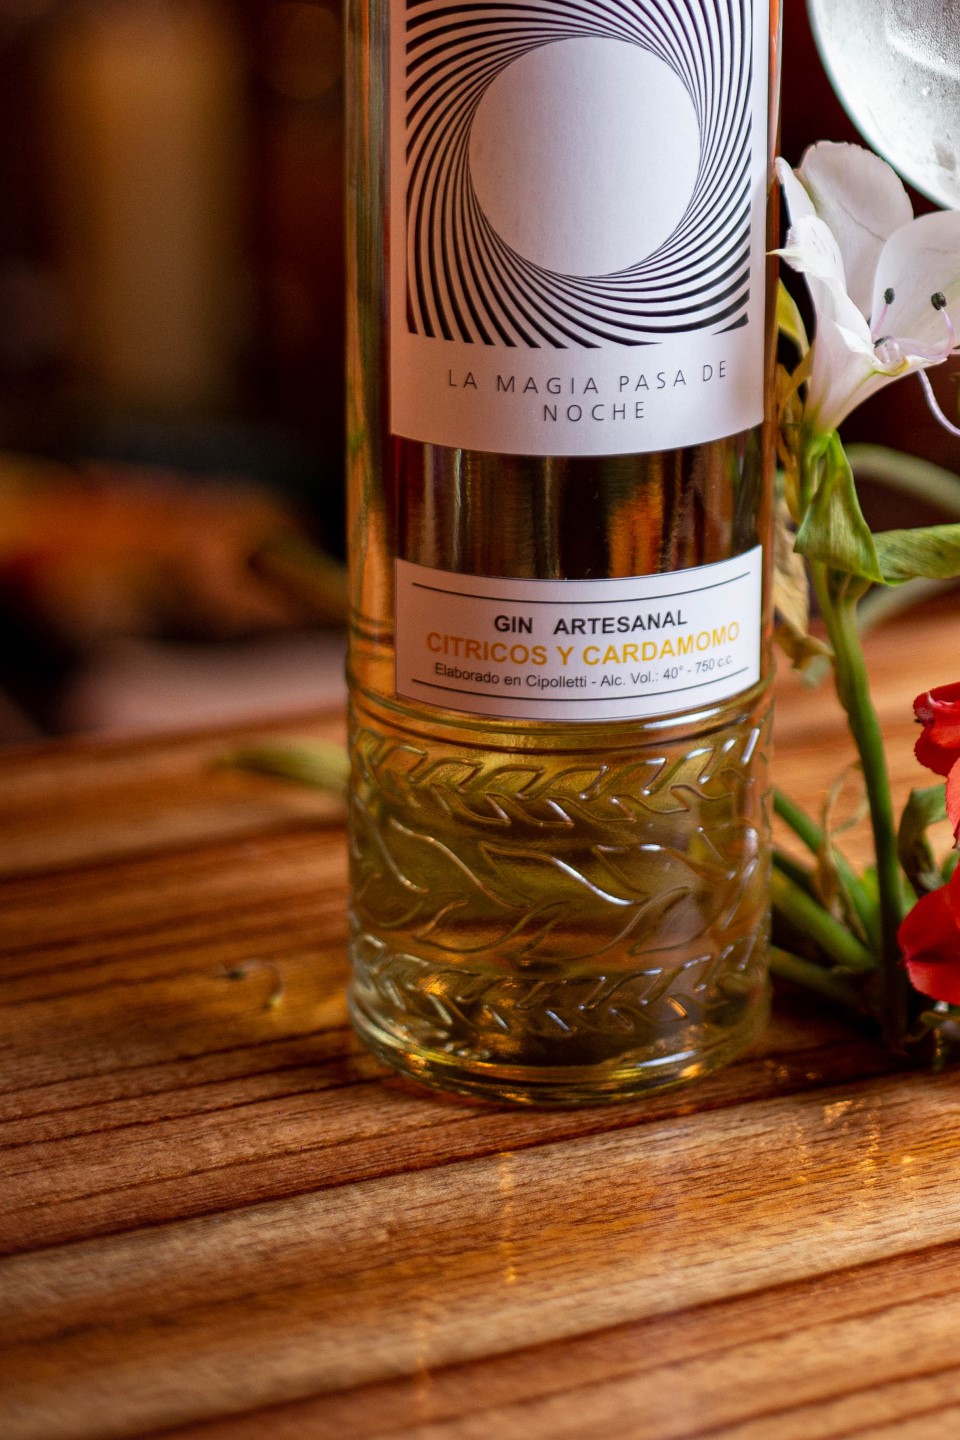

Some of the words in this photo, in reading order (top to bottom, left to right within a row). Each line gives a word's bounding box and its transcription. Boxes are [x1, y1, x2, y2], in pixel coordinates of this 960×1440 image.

[449, 369, 478, 389] LA
[497, 375, 599, 394] MAGIA
[619, 370, 687, 392] PASA
[702, 360, 727, 382] DE
[543, 401, 645, 422] NOCHE
[494, 614, 533, 634] GIN
[553, 610, 687, 635] ARTESANAL
[426, 631, 548, 666] CITRICOS
[556, 645, 574, 665] Y
[582, 621, 740, 666] CARDAMOMO
[434, 662, 500, 685] Elaborado
[504, 675, 521, 686] en
[526, 673, 587, 690] Cipolletti
[600, 674, 626, 687] Alc.
[695, 658, 715, 674] 750
